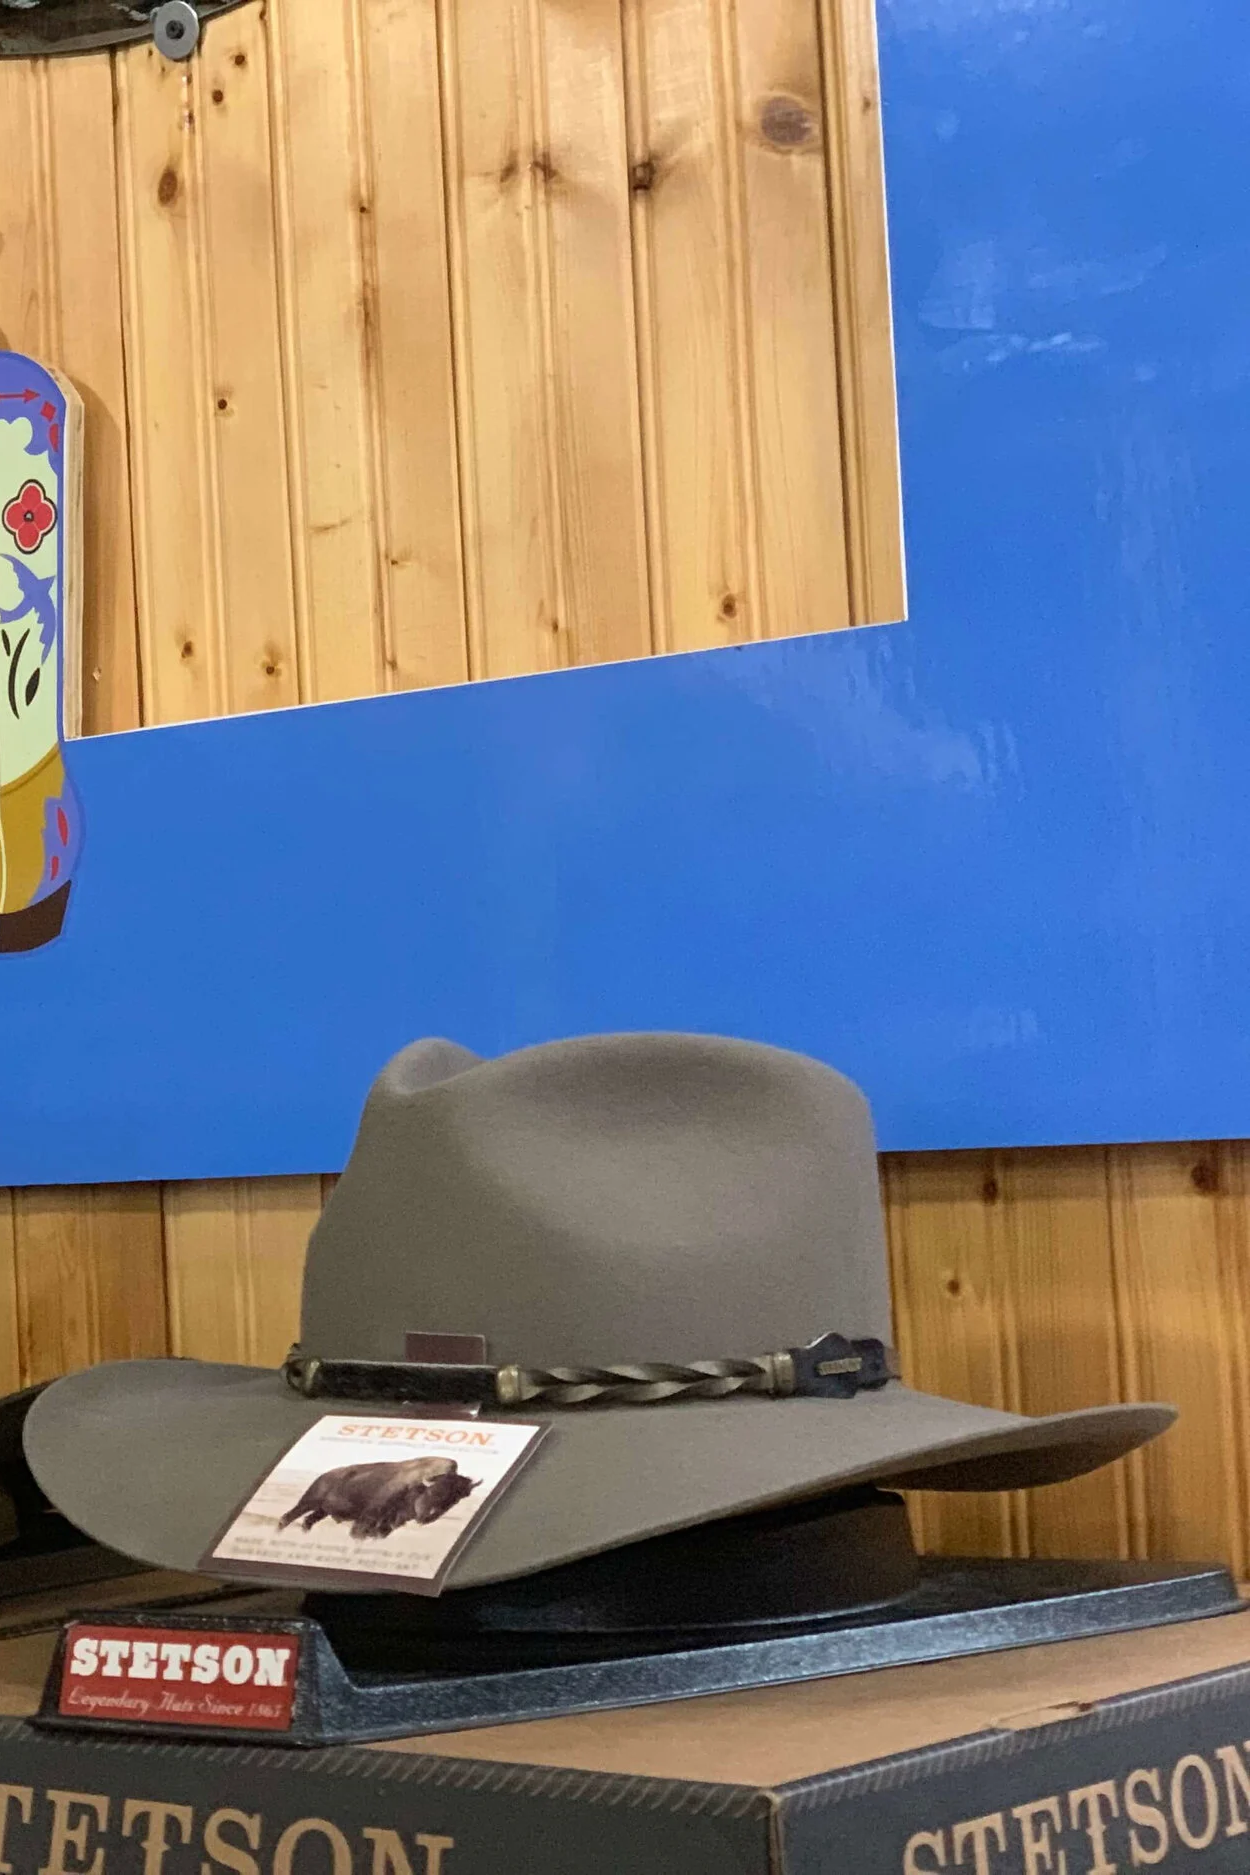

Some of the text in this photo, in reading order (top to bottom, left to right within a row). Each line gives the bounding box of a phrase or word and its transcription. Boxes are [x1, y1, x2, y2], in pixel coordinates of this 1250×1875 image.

[338, 1423, 496, 1447] STETSON
[70, 1638, 291, 1687] STETSON
[67, 1686, 150, 1717] Legendary
[156, 1691, 193, 1713] Hats
[199, 1693, 244, 1716] Since
